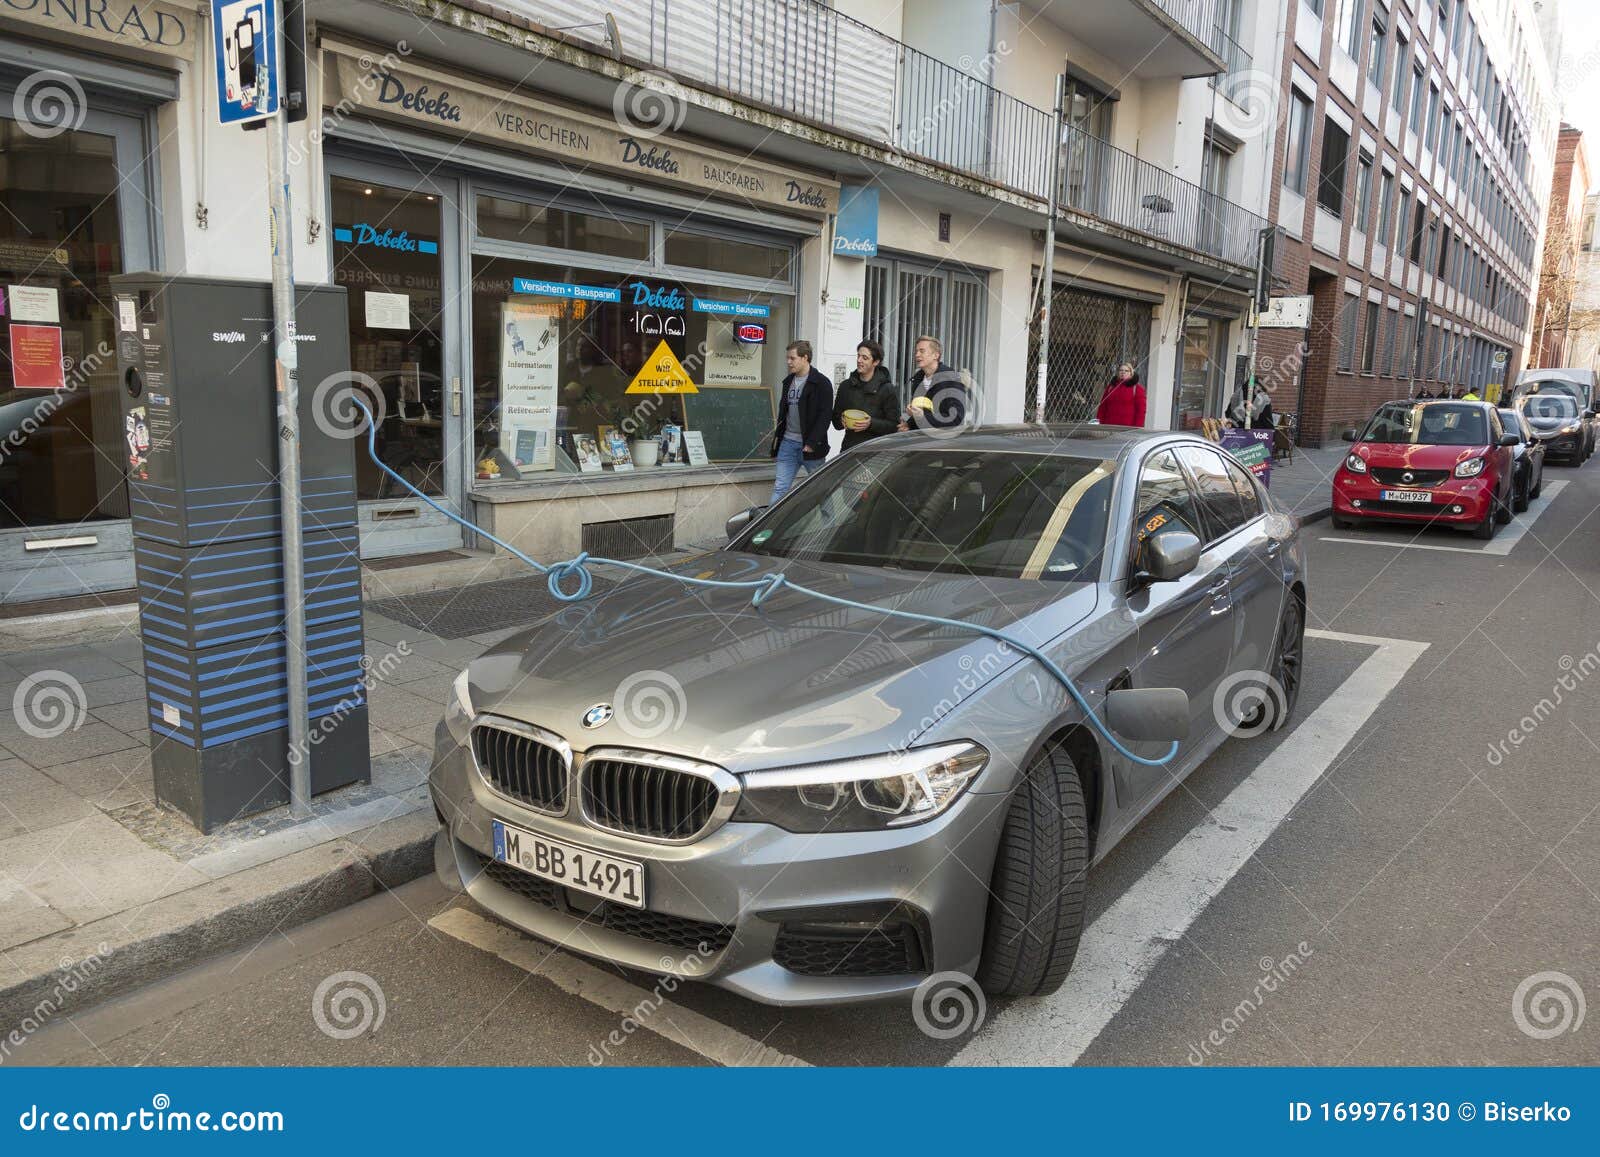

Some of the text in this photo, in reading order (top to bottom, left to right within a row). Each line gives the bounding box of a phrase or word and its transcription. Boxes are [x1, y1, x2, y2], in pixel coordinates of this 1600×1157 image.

[371, 72, 828, 209] Debeka VERSICHERN Debeka BAUSPAREN Debeka
[353, 223, 417, 251] Debeka
[834, 236, 875, 252] Debeka
[520, 281, 565, 294] Versichern
[574, 288, 616, 299] Bausparen
[629, 282, 686, 310] Debeka
[698, 301, 767, 315] Versichern Bausparen
[740, 327, 765, 339] OPEN
[655, 364, 671, 373] WIR
[638, 379, 670, 387] STELLEN
[534, 842, 567, 879] BB
[572, 853, 640, 902] 1491
